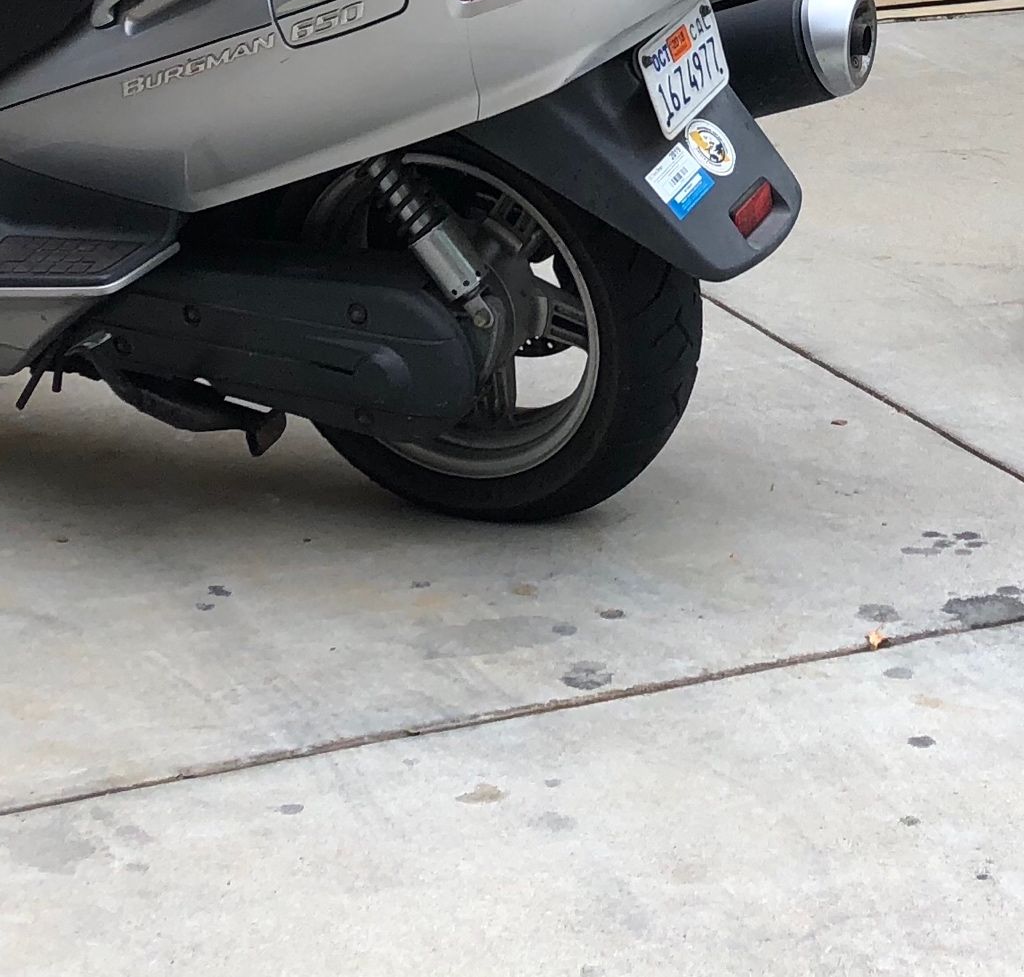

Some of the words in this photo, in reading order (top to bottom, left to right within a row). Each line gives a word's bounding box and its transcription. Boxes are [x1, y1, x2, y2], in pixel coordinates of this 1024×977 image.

[121, 32, 275, 97] BURGMAN
[290, 1, 364, 42] 650
[689, 14, 711, 41] CAL
[651, 44, 671, 72] OCT
[658, 36, 719, 118] 16Z4977
